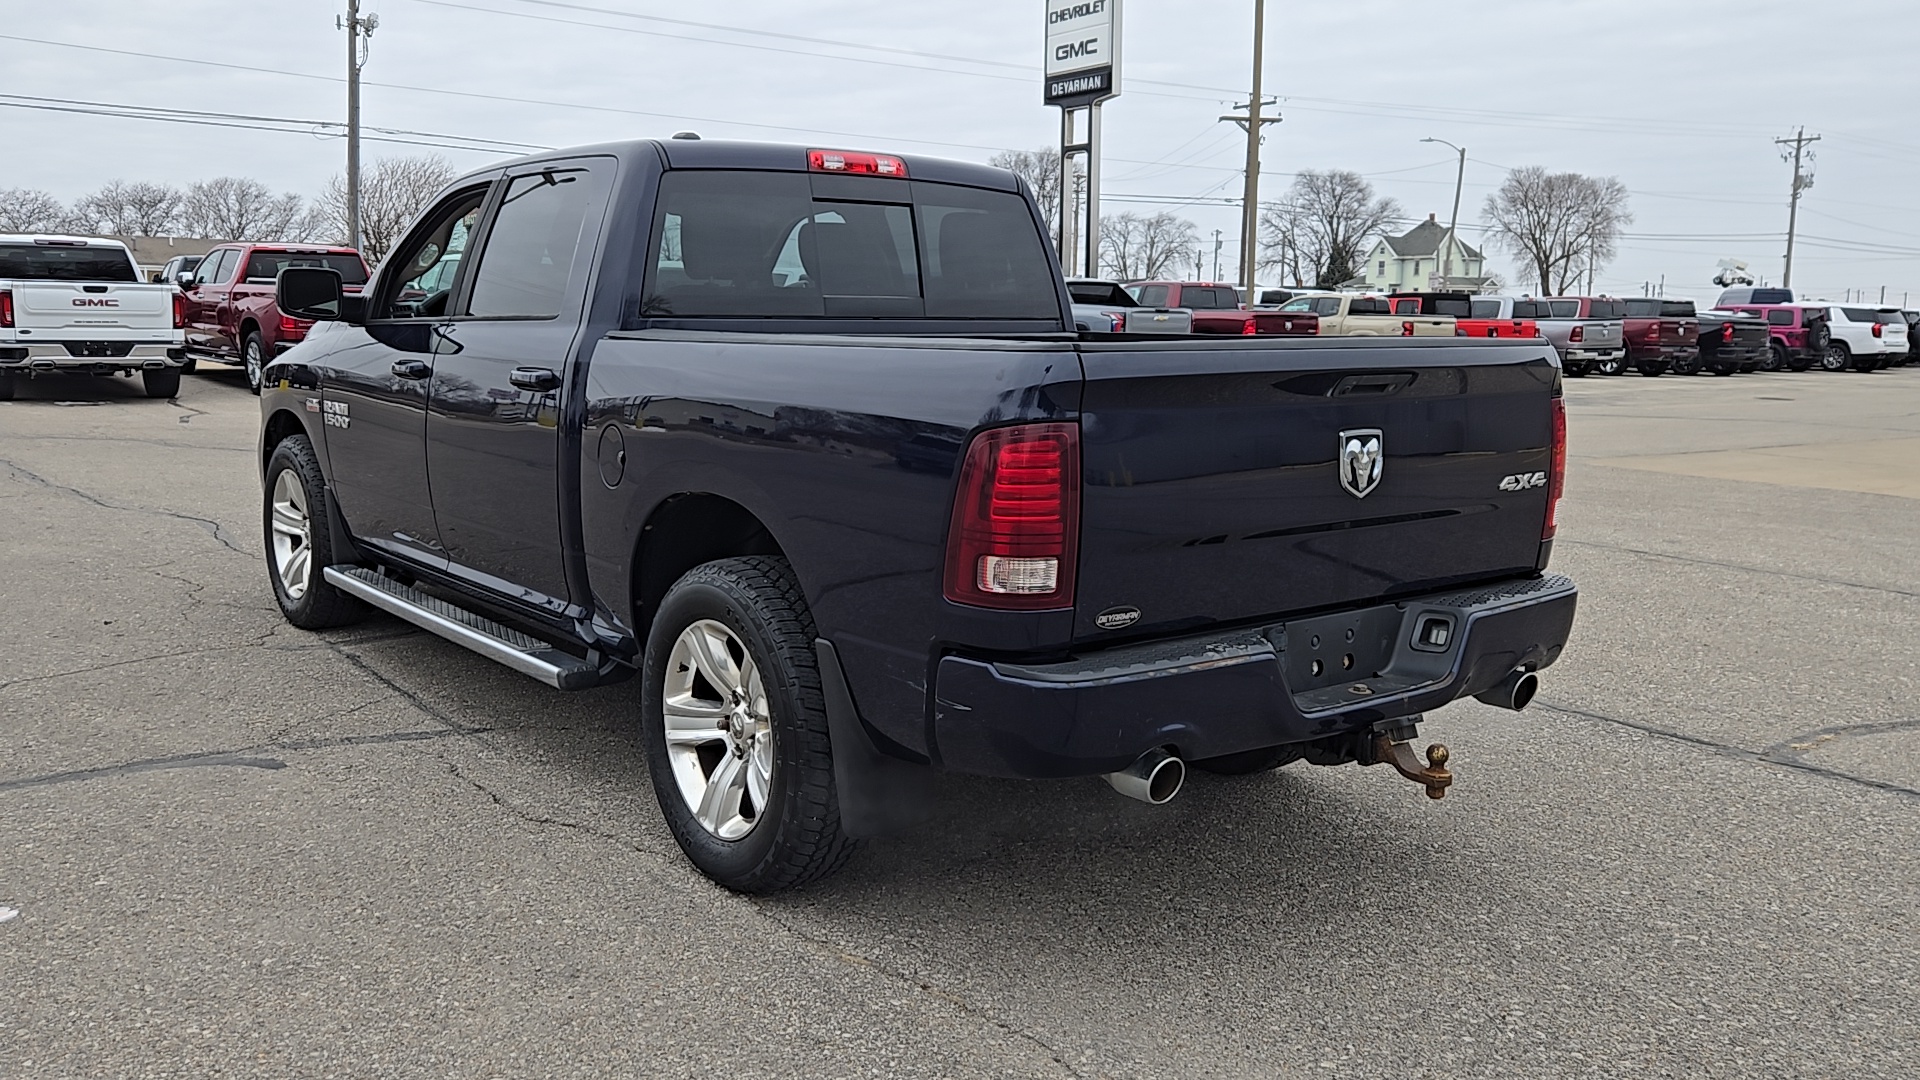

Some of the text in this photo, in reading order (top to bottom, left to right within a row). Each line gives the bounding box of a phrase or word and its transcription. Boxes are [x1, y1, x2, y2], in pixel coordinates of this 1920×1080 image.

[1049, 0, 1105, 24] CHEVROLET
[1055, 37, 1098, 61] GMC
[1051, 75, 1101, 96] DEYARMAN
[72, 298, 119, 307] GMC
[324, 412, 350, 429] 1500
